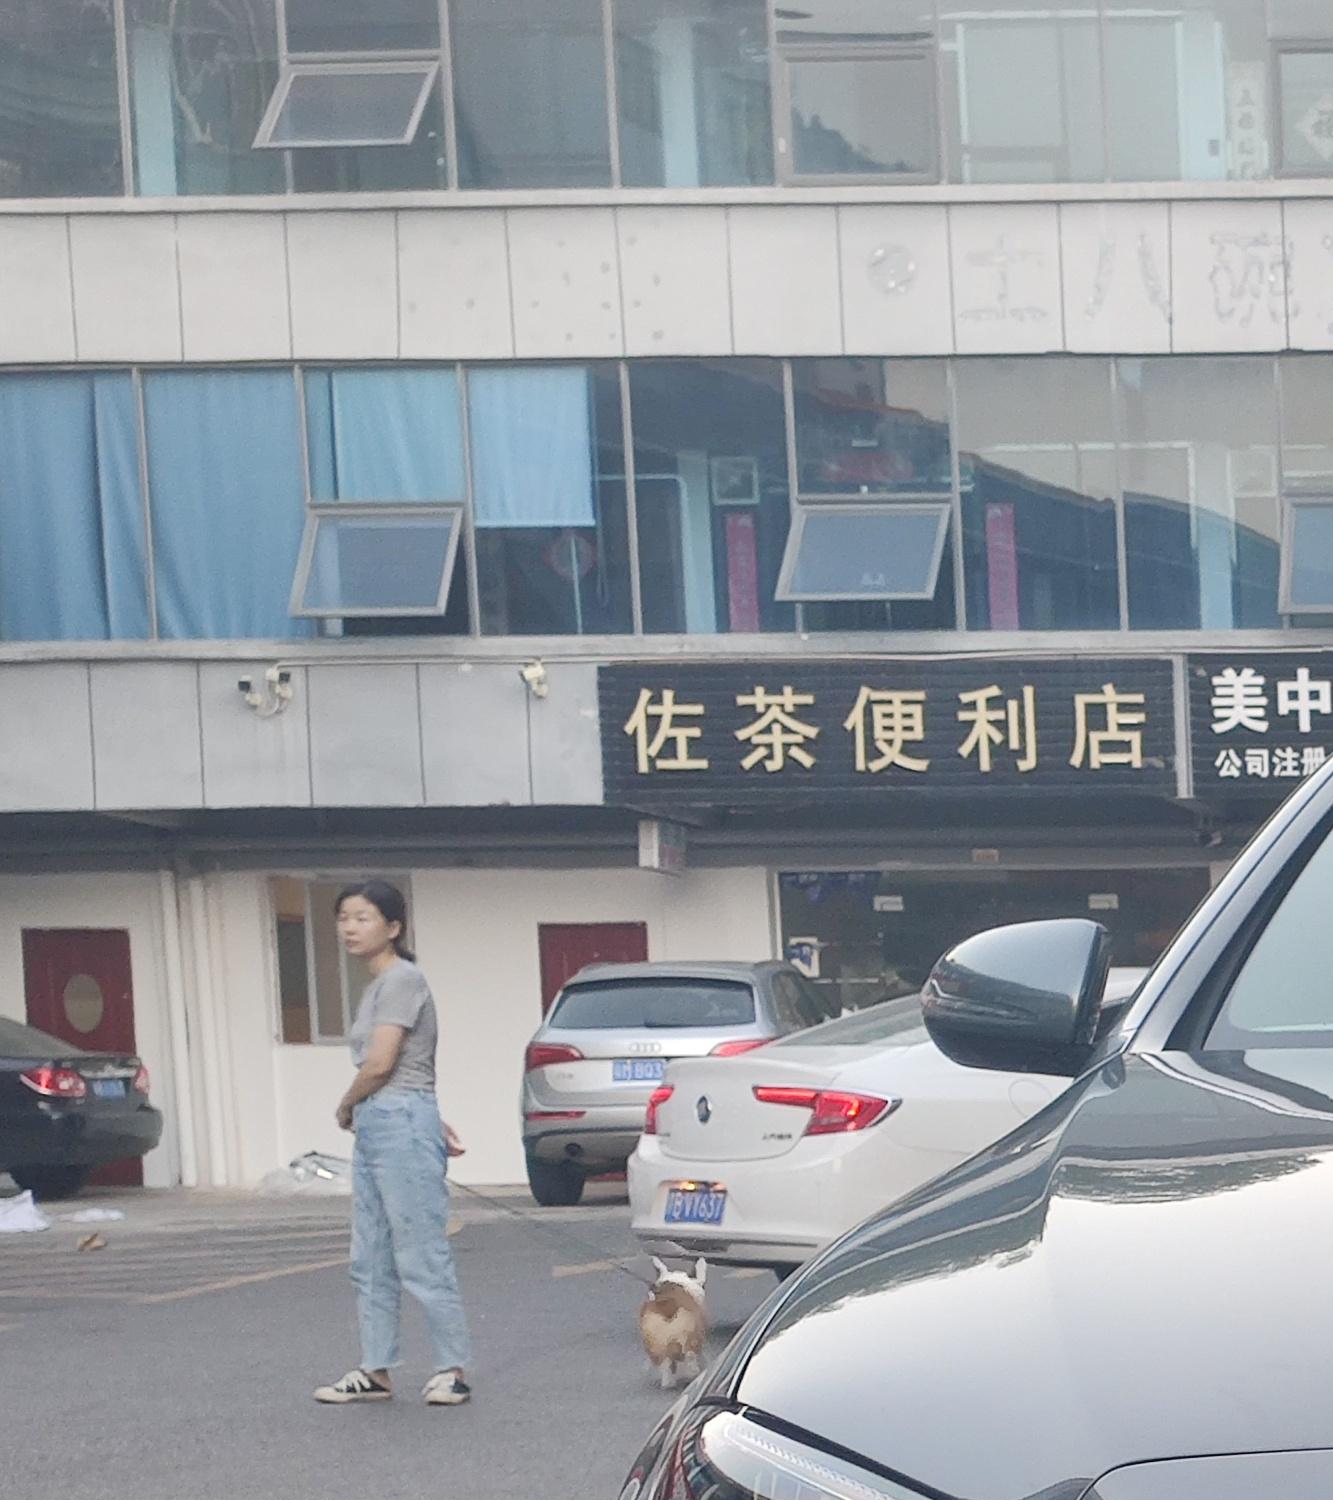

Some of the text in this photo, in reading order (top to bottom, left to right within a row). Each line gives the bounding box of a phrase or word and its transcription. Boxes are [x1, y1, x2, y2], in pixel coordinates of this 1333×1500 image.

[624, 684, 1147, 774] 佐茶便利店
